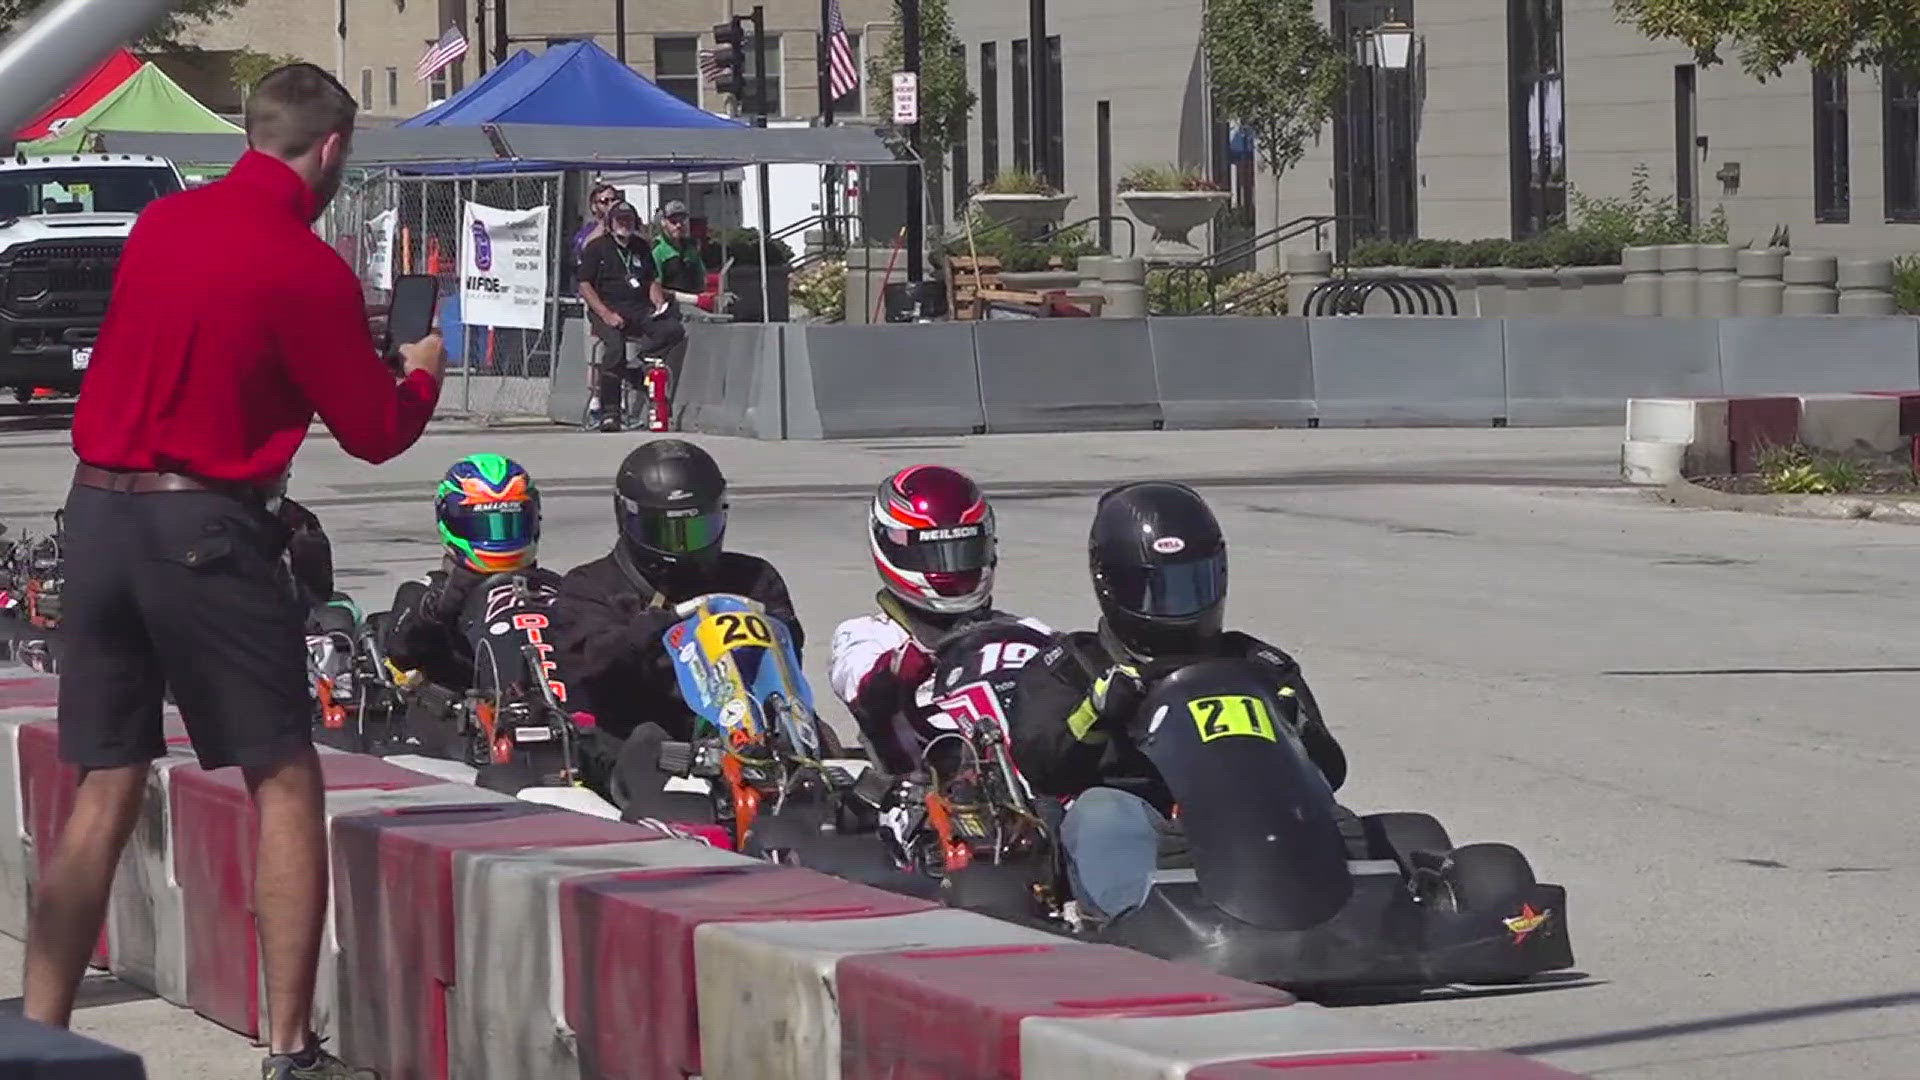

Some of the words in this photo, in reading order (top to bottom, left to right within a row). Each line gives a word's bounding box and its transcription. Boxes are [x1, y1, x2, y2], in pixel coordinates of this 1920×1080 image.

[919, 526, 978, 542] NEILSON
[715, 614, 772, 645] 20
[979, 641, 1039, 675] 19
[1196, 697, 1262, 737] 21
